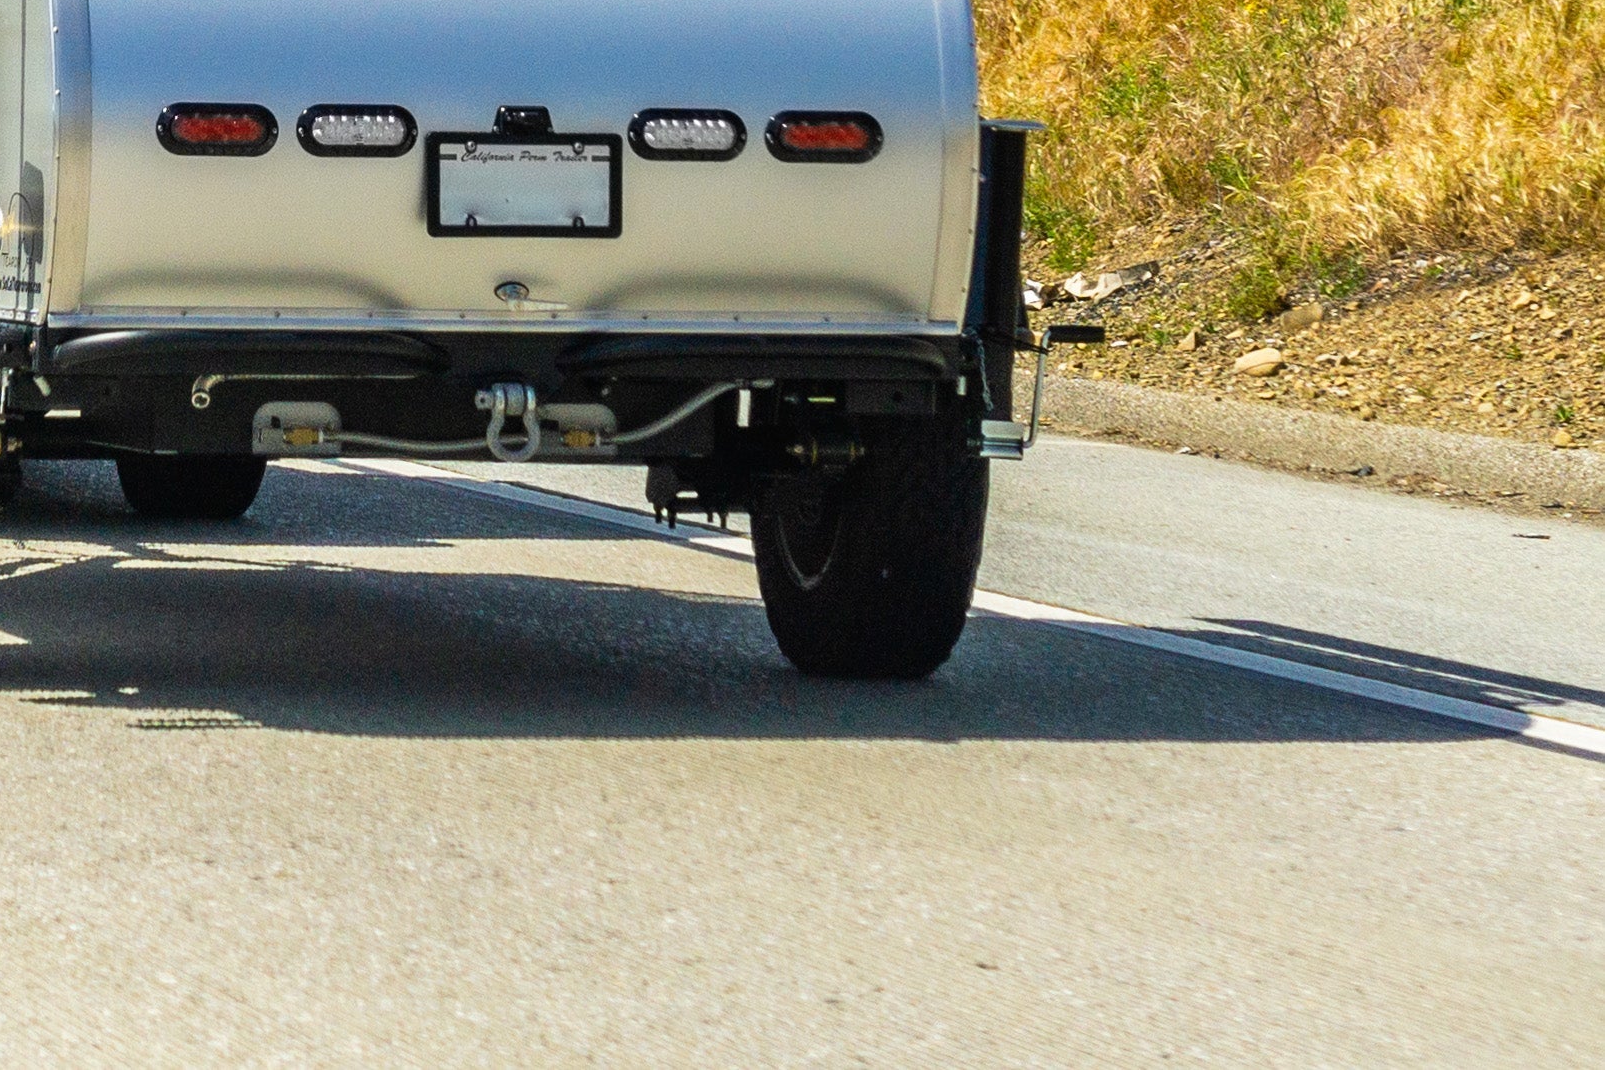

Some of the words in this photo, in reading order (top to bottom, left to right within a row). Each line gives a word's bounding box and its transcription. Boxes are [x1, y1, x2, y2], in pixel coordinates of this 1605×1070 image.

[461, 151, 514, 164] California
[518, 150, 547, 162] Perm
[553, 150, 588, 162] Trailer
